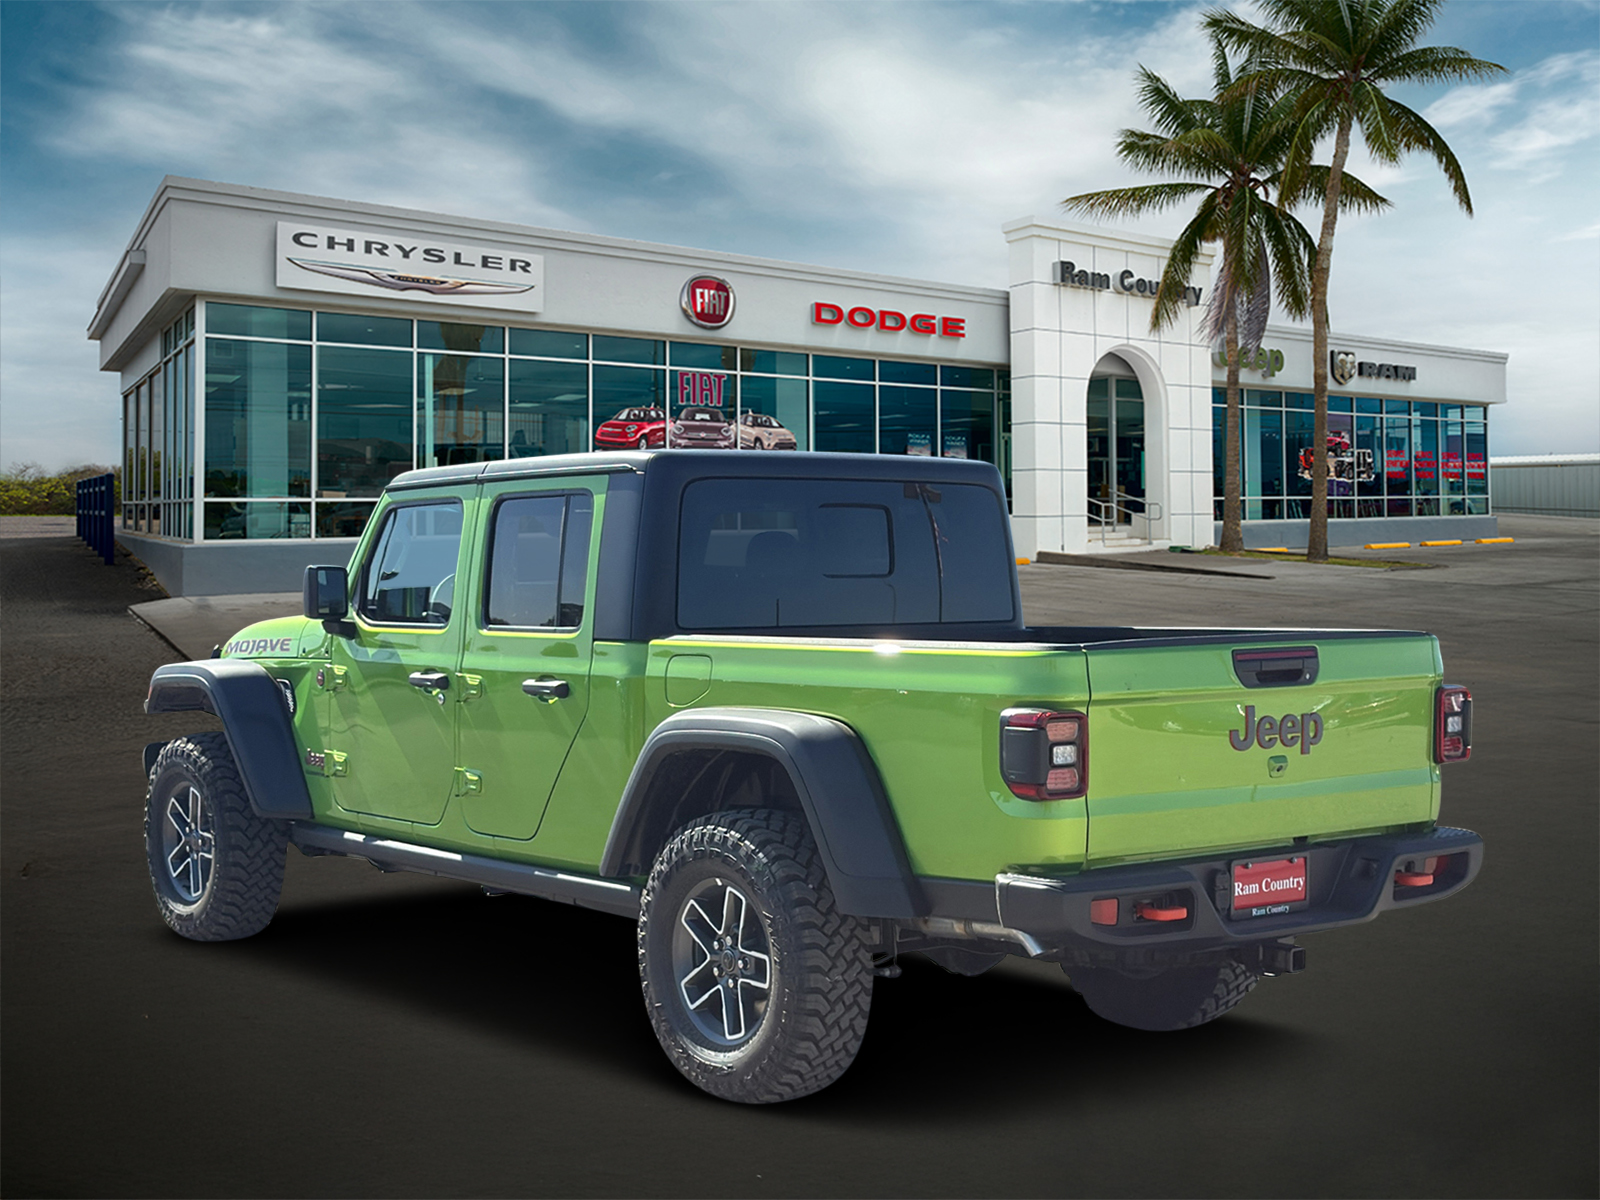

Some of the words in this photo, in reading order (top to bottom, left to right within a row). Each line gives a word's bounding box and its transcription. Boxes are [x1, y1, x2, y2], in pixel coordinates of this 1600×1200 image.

[292, 232, 532, 273] CHRYSLER
[1053, 260, 1110, 289] Ram
[1114, 269, 1203, 306] Coury
[695, 288, 727, 316] FIAT
[812, 302, 966, 338] DODGE
[1358, 362, 1416, 380] RAM
[678, 371, 727, 406] FIAT
[224, 638, 292, 655] MOJAVE
[1229, 705, 1324, 755] Jeep
[1234, 881, 1260, 896] Ram
[1262, 876, 1305, 893] Country
[1252, 908, 1266, 916] Ram
[1266, 905, 1290, 914] Country
